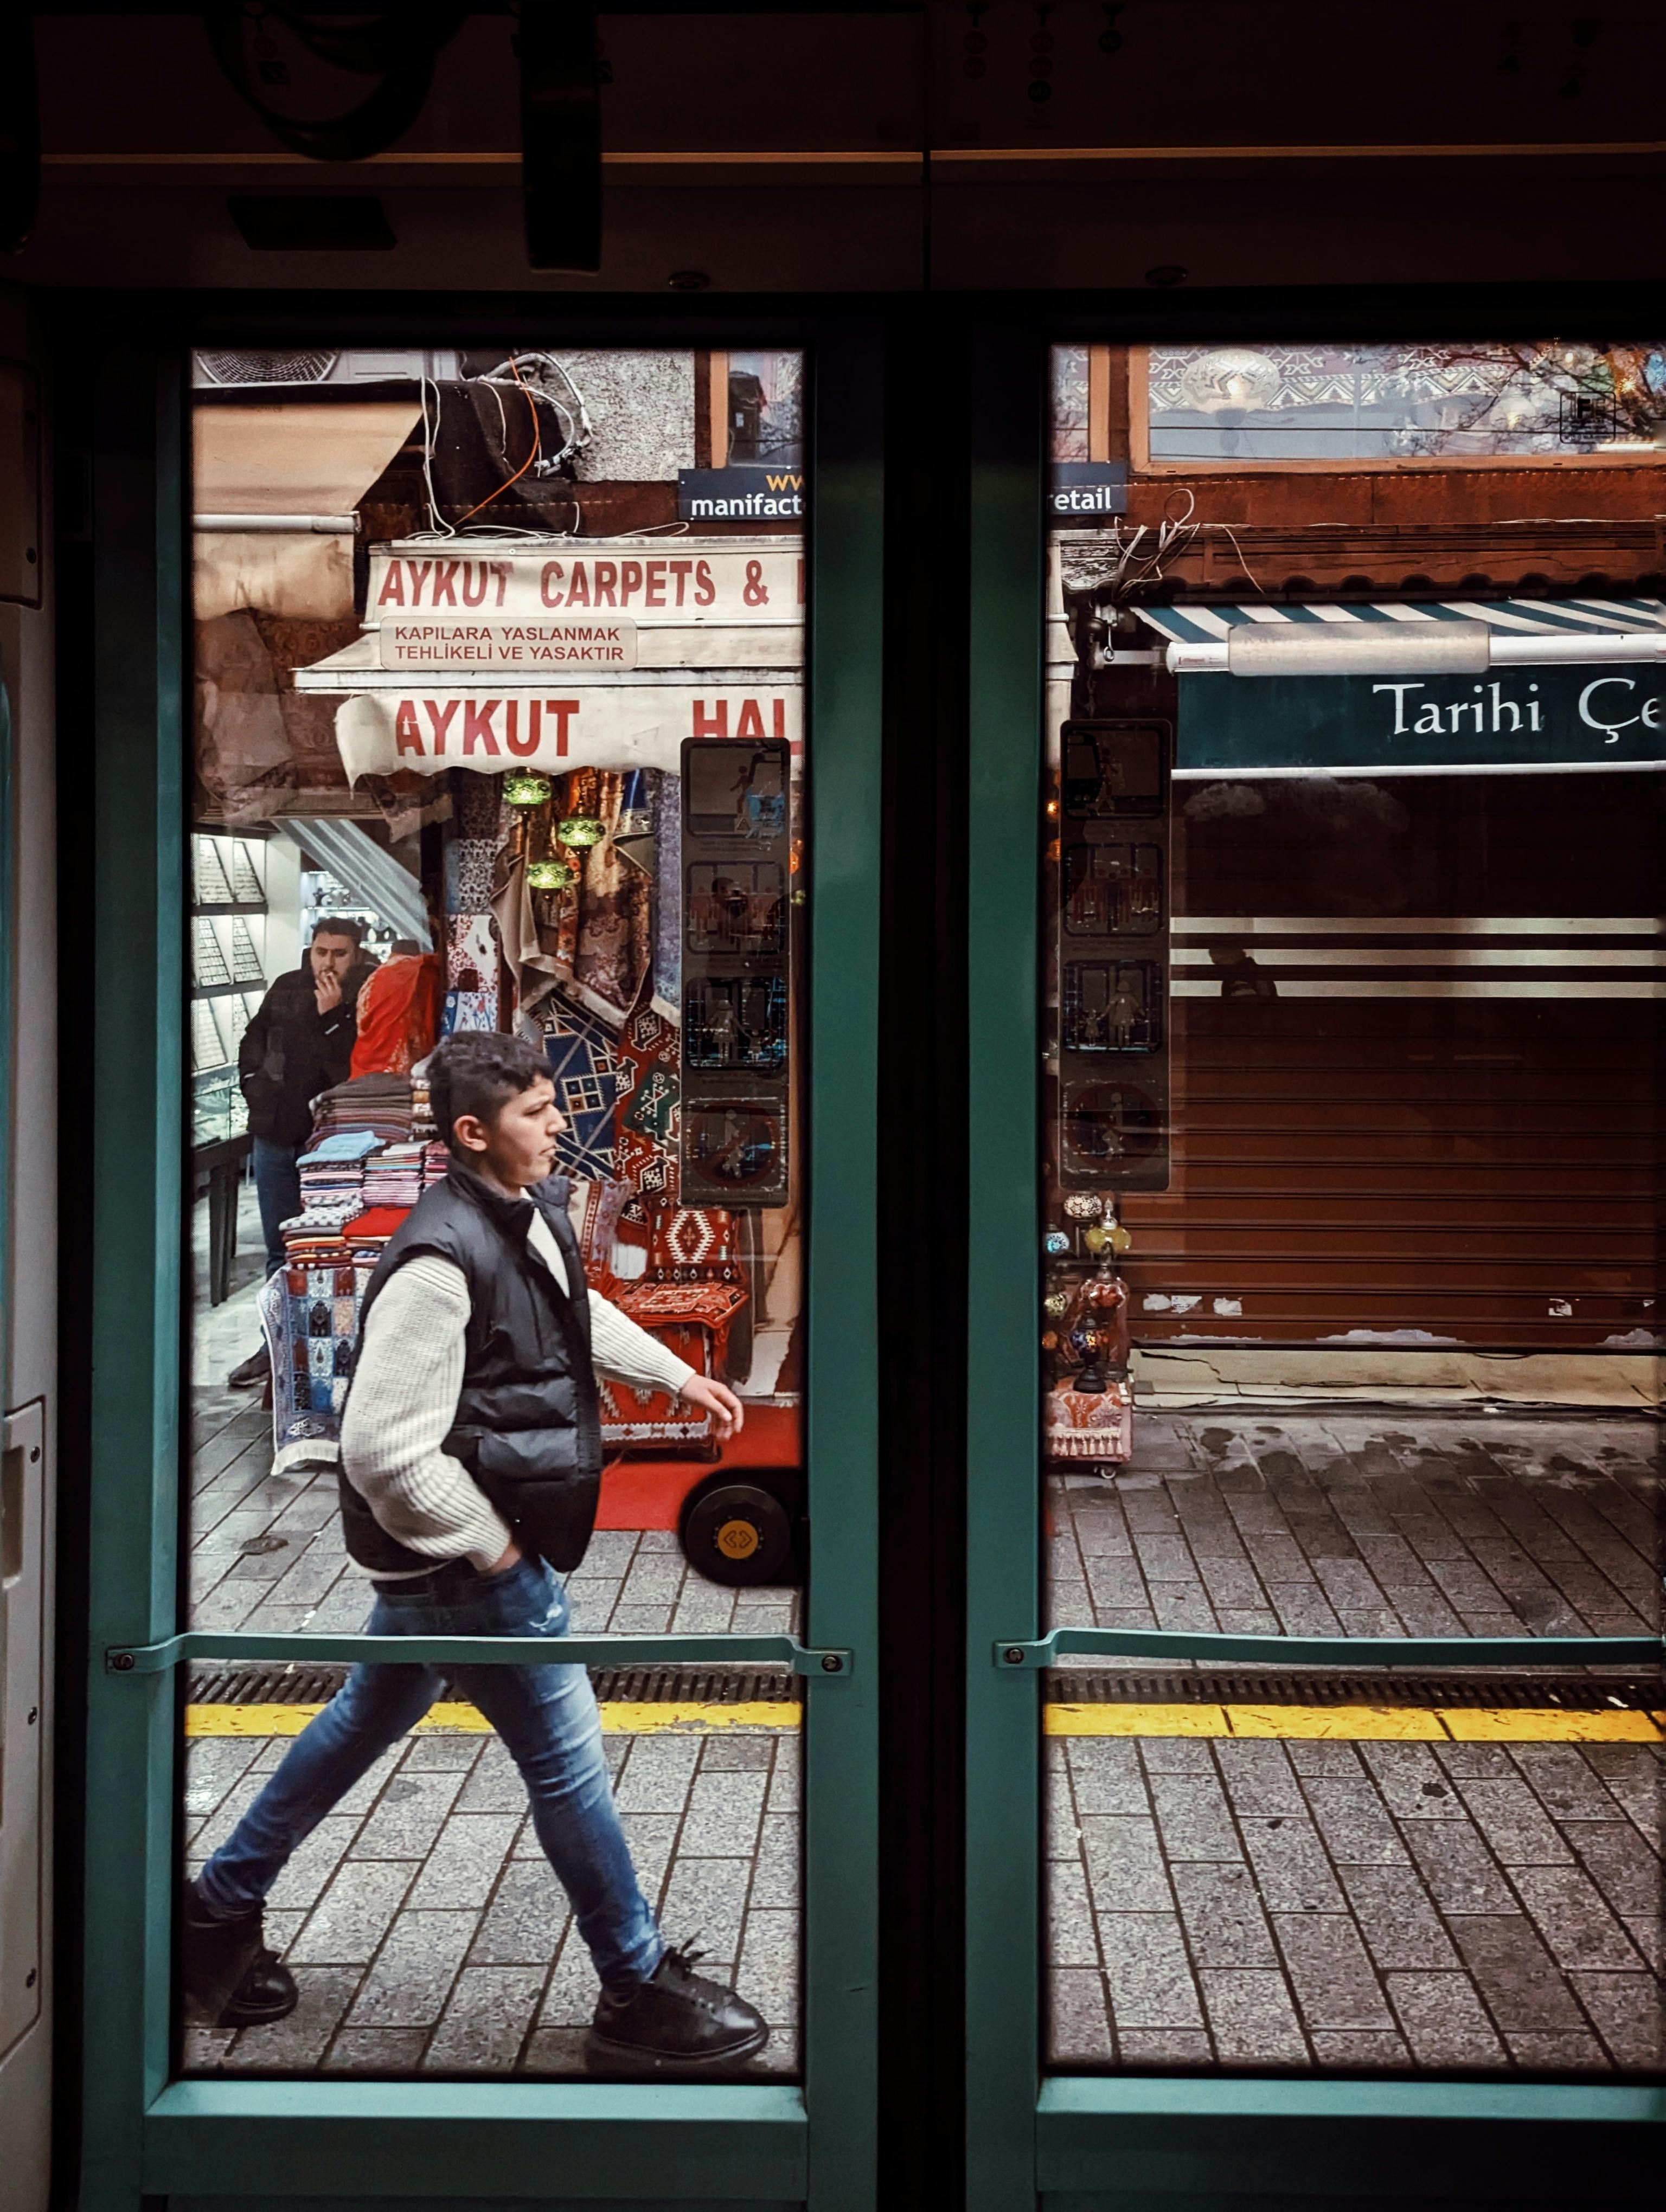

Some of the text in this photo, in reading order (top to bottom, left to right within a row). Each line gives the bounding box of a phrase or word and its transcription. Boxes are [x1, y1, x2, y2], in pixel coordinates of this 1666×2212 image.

[1049, 487, 1112, 511] etail
[378, 560, 513, 607] AYKUT
[541, 560, 715, 607] CARPETS
[742, 560, 770, 607] &
[395, 626, 620, 641] KAPILARA YASLANMAK
[395, 643, 624, 660] TEHLİKELİ VE YASAKTIR
[1372, 682, 1542, 735] Tarihi
[395, 699, 580, 757] AYKUT
